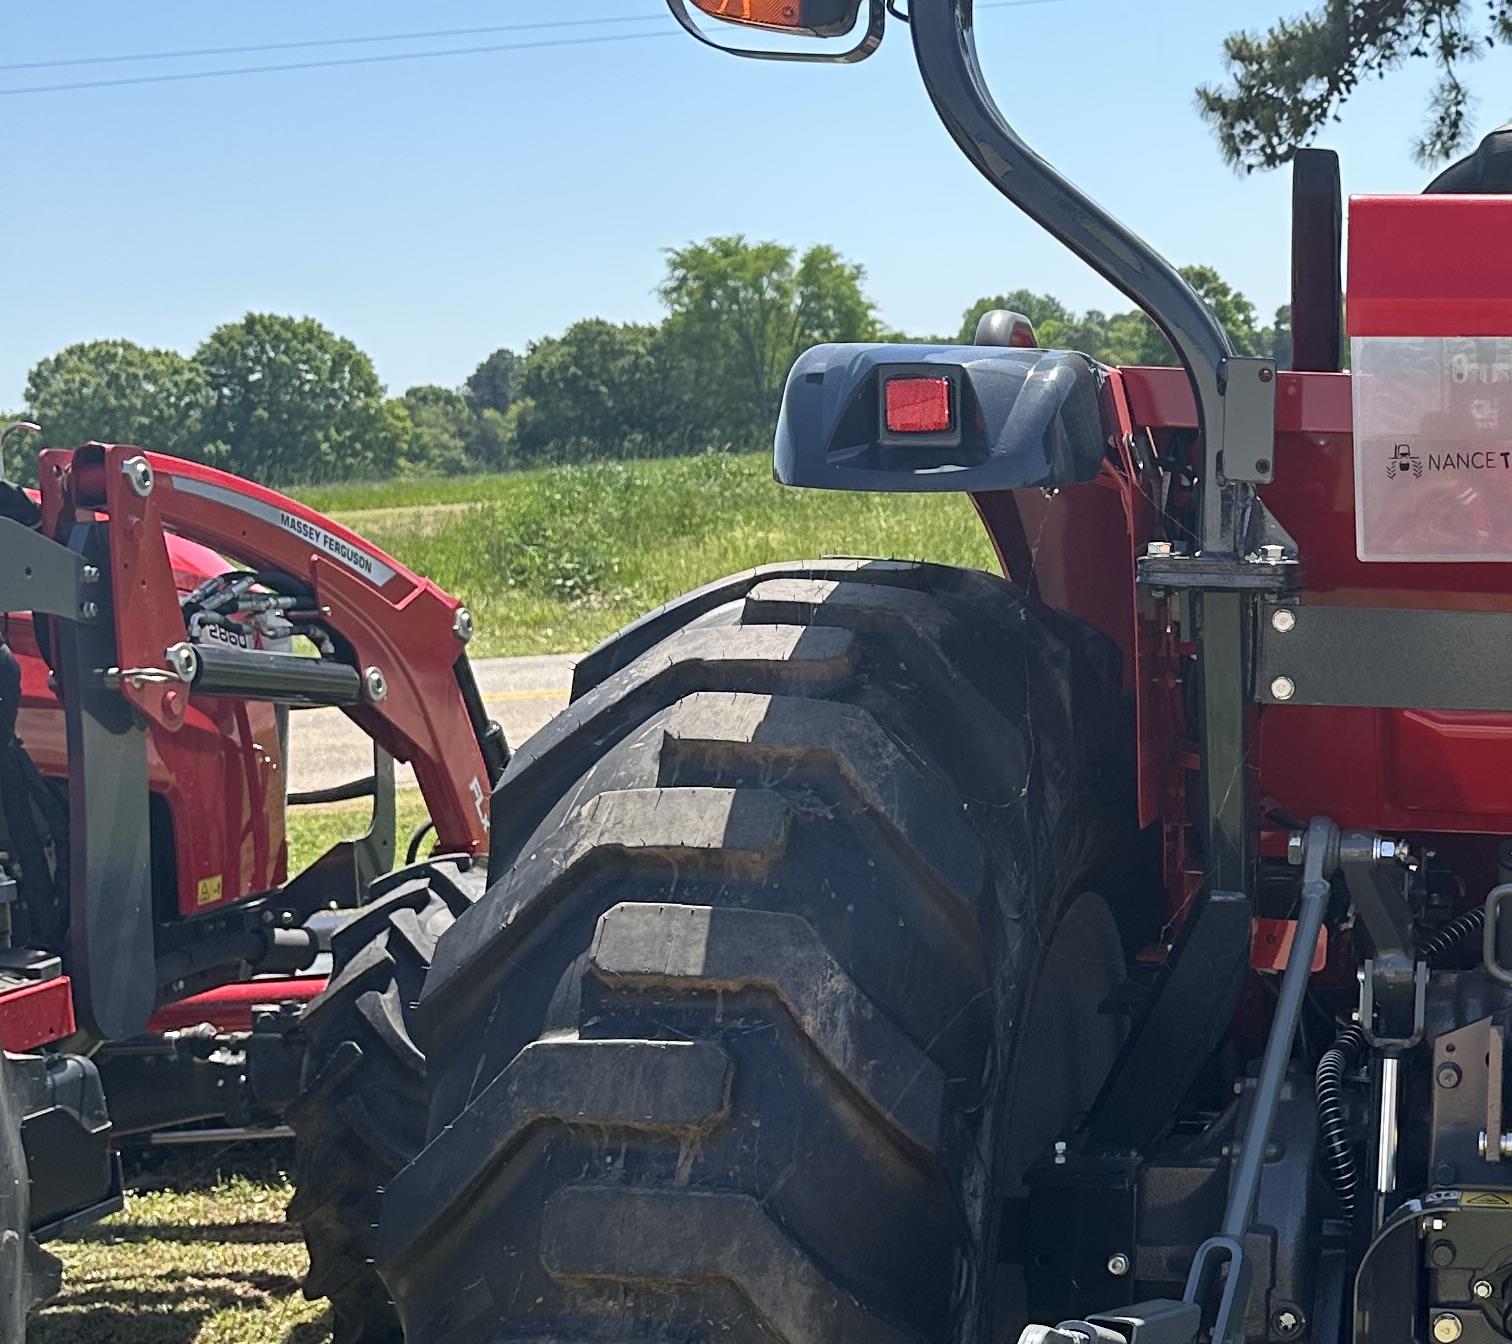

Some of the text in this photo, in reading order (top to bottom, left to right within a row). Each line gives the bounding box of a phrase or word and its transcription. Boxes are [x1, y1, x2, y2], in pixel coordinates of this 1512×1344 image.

[1428, 451, 1496, 471] NANCE
[280, 513, 372, 573] MASSEY FERGUSON
